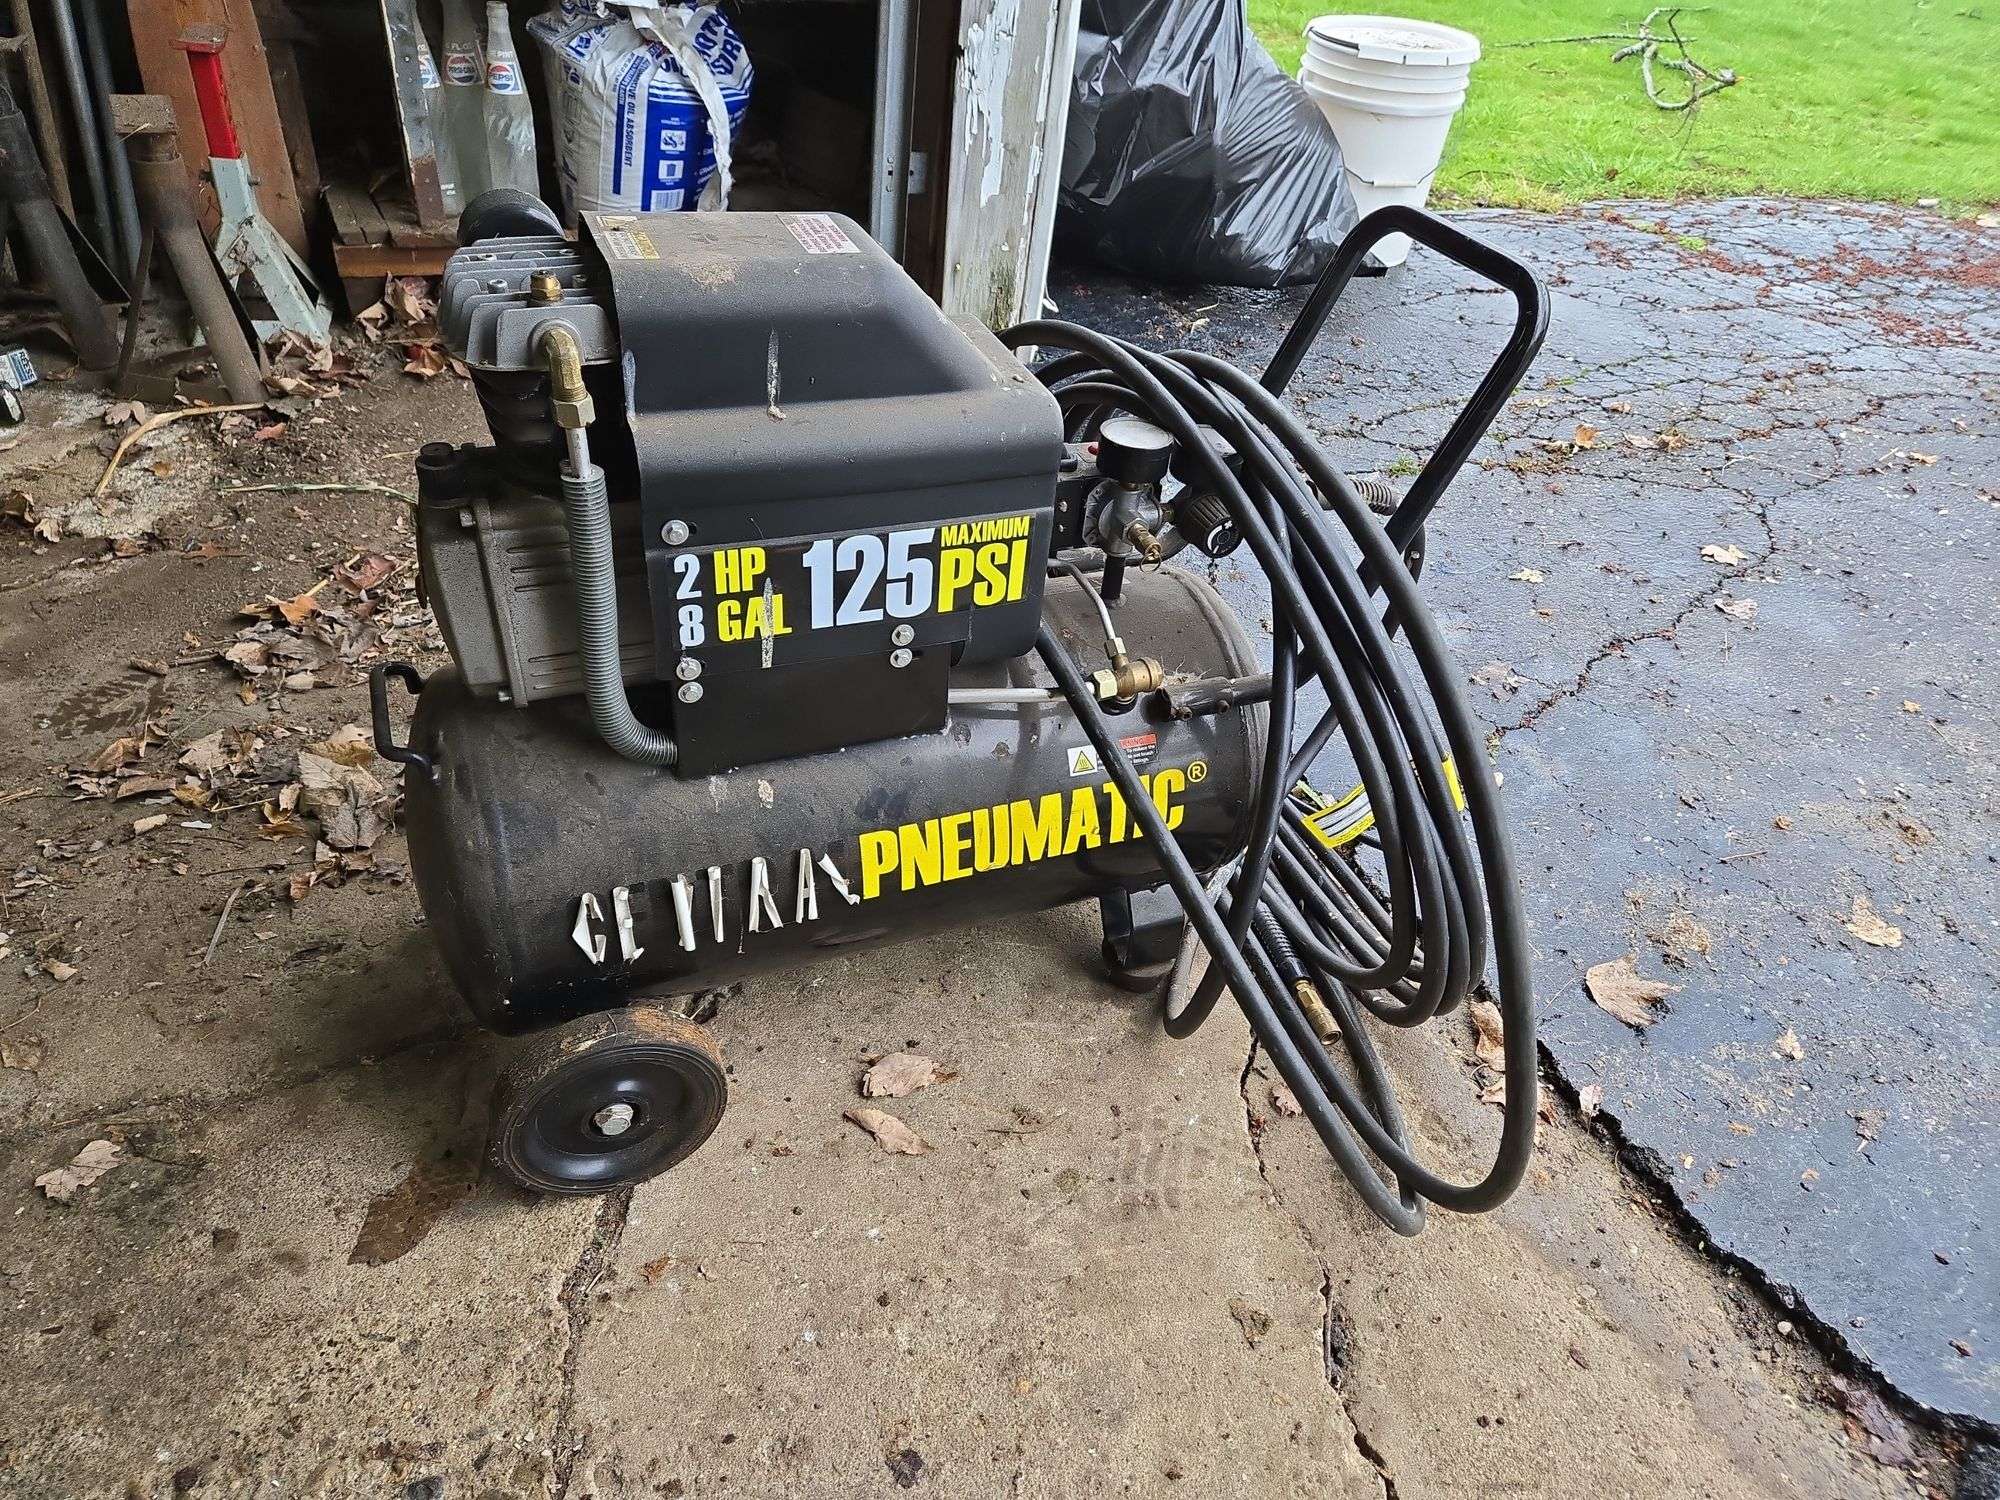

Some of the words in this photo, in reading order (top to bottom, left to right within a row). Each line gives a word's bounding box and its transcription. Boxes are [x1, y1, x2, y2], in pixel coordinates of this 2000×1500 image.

[627, 101, 636, 117] OIL
[624, 117, 635, 168] ABSORBENT
[940, 516, 1030, 547] MAXIMUM
[673, 553, 702, 600] 2
[713, 546, 766, 595] HP
[802, 528, 936, 630] 125
[937, 539, 1028, 613] PSI
[677, 604, 705, 647] 8
[717, 593, 793, 642] GAL
